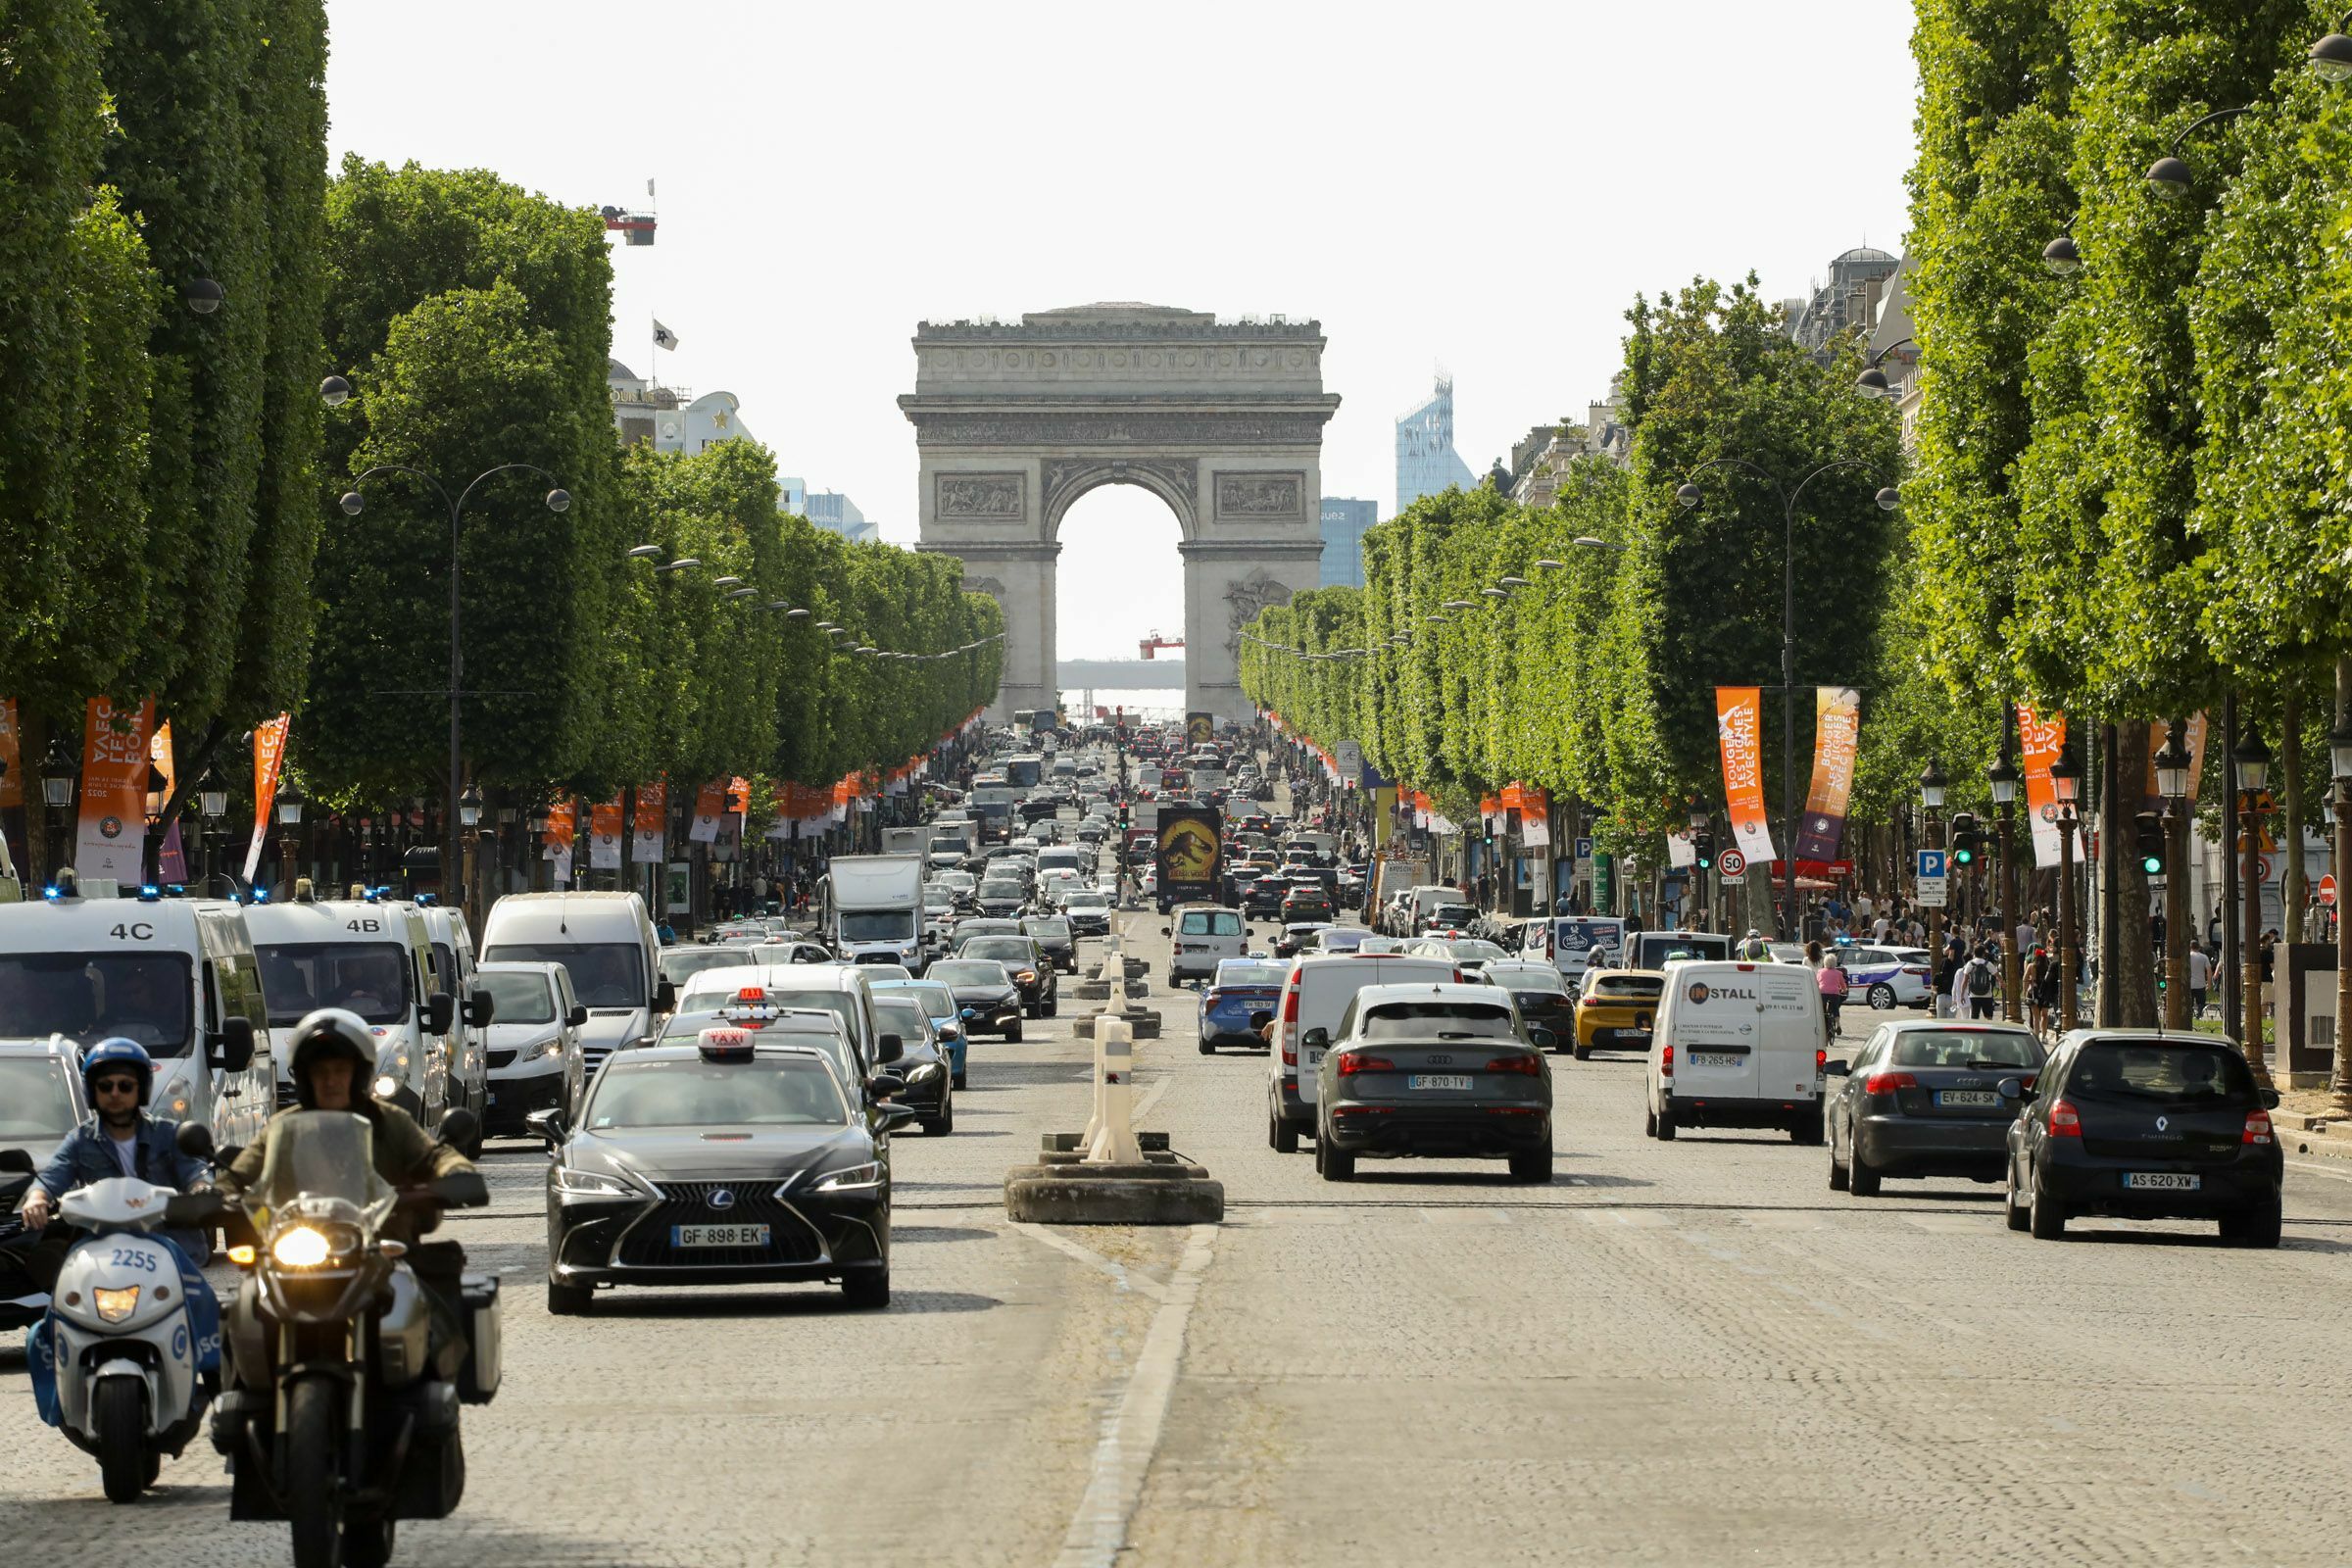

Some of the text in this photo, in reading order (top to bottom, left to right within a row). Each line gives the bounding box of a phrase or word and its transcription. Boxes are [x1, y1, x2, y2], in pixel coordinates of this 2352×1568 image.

[1734, 710, 1747, 788] LES LIGNES
[1744, 707, 1756, 788] AVEC STYLE
[1821, 714, 1834, 767] BOUGER
[1828, 714, 1843, 787] LES LIGNES
[1725, 729, 1738, 790] BOUGER
[1836, 755, 1848, 792] AVEC
[1725, 858, 1741, 869] 50
[1925, 856, 1938, 873] P
[110, 923, 153, 940] 4C
[347, 920, 380, 932] 4B
[741, 988, 761, 997] TAXI
[710, 1034, 744, 1045] TAXI
[110, 1249, 157, 1272] 2255
